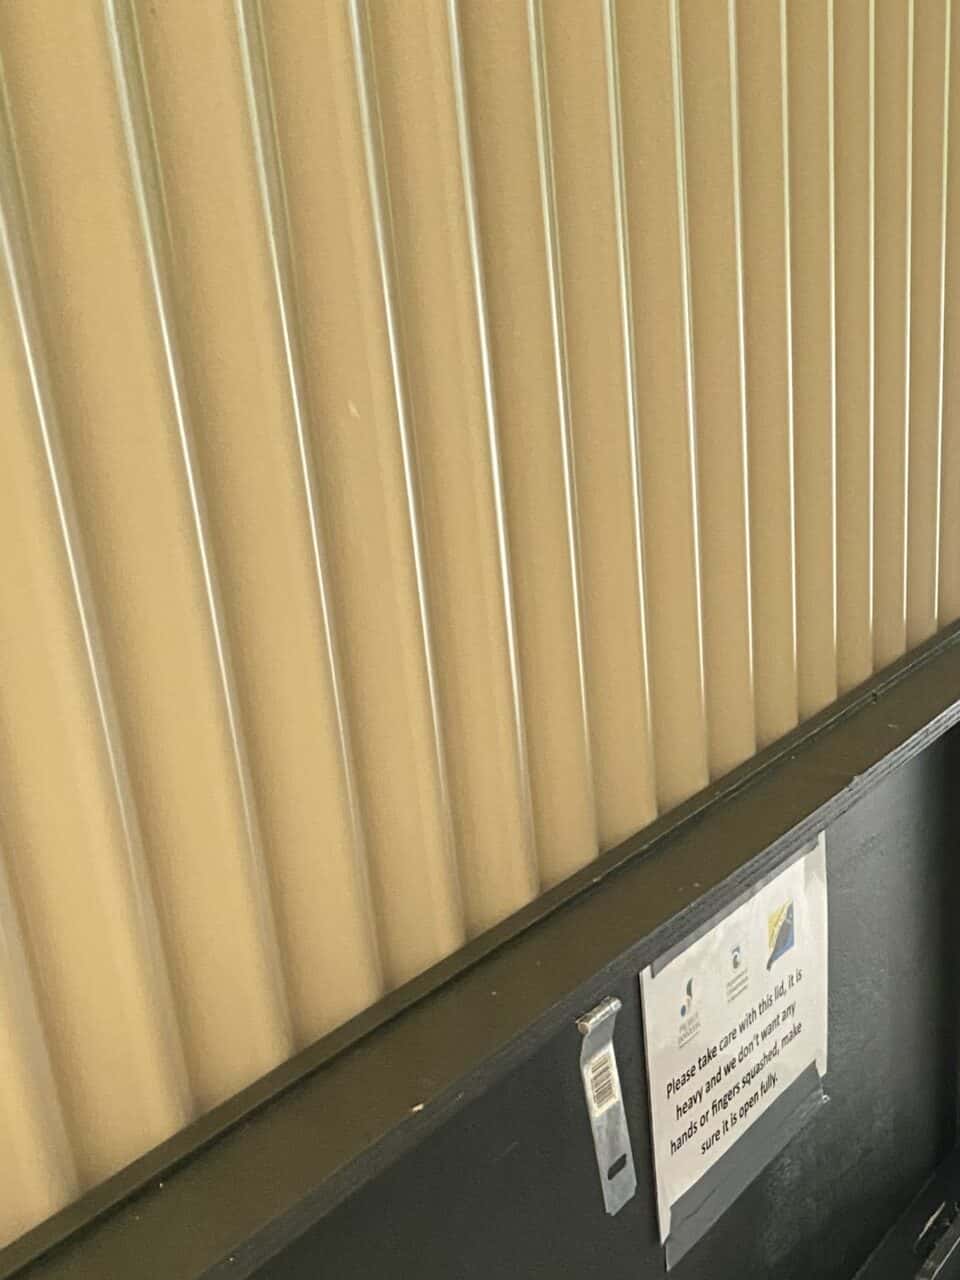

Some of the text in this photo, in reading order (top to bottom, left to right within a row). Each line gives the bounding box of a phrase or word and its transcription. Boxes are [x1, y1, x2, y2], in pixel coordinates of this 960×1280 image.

[666, 1064, 696, 1099] Please
[697, 1045, 718, 1070] take
[719, 1028, 737, 1051] care
[739, 1008, 757, 1033] with
[758, 993, 773, 1015] this
[774, 979, 787, 1000] lid,
[788, 974, 795, 989] it
[795, 968, 803, 983] is
[670, 1021, 802, 1155] hands or fingers squashed, make
[676, 1001, 797, 1120] heavy and we don't want any
[701, 1072, 778, 1154] sure it is open fully.
